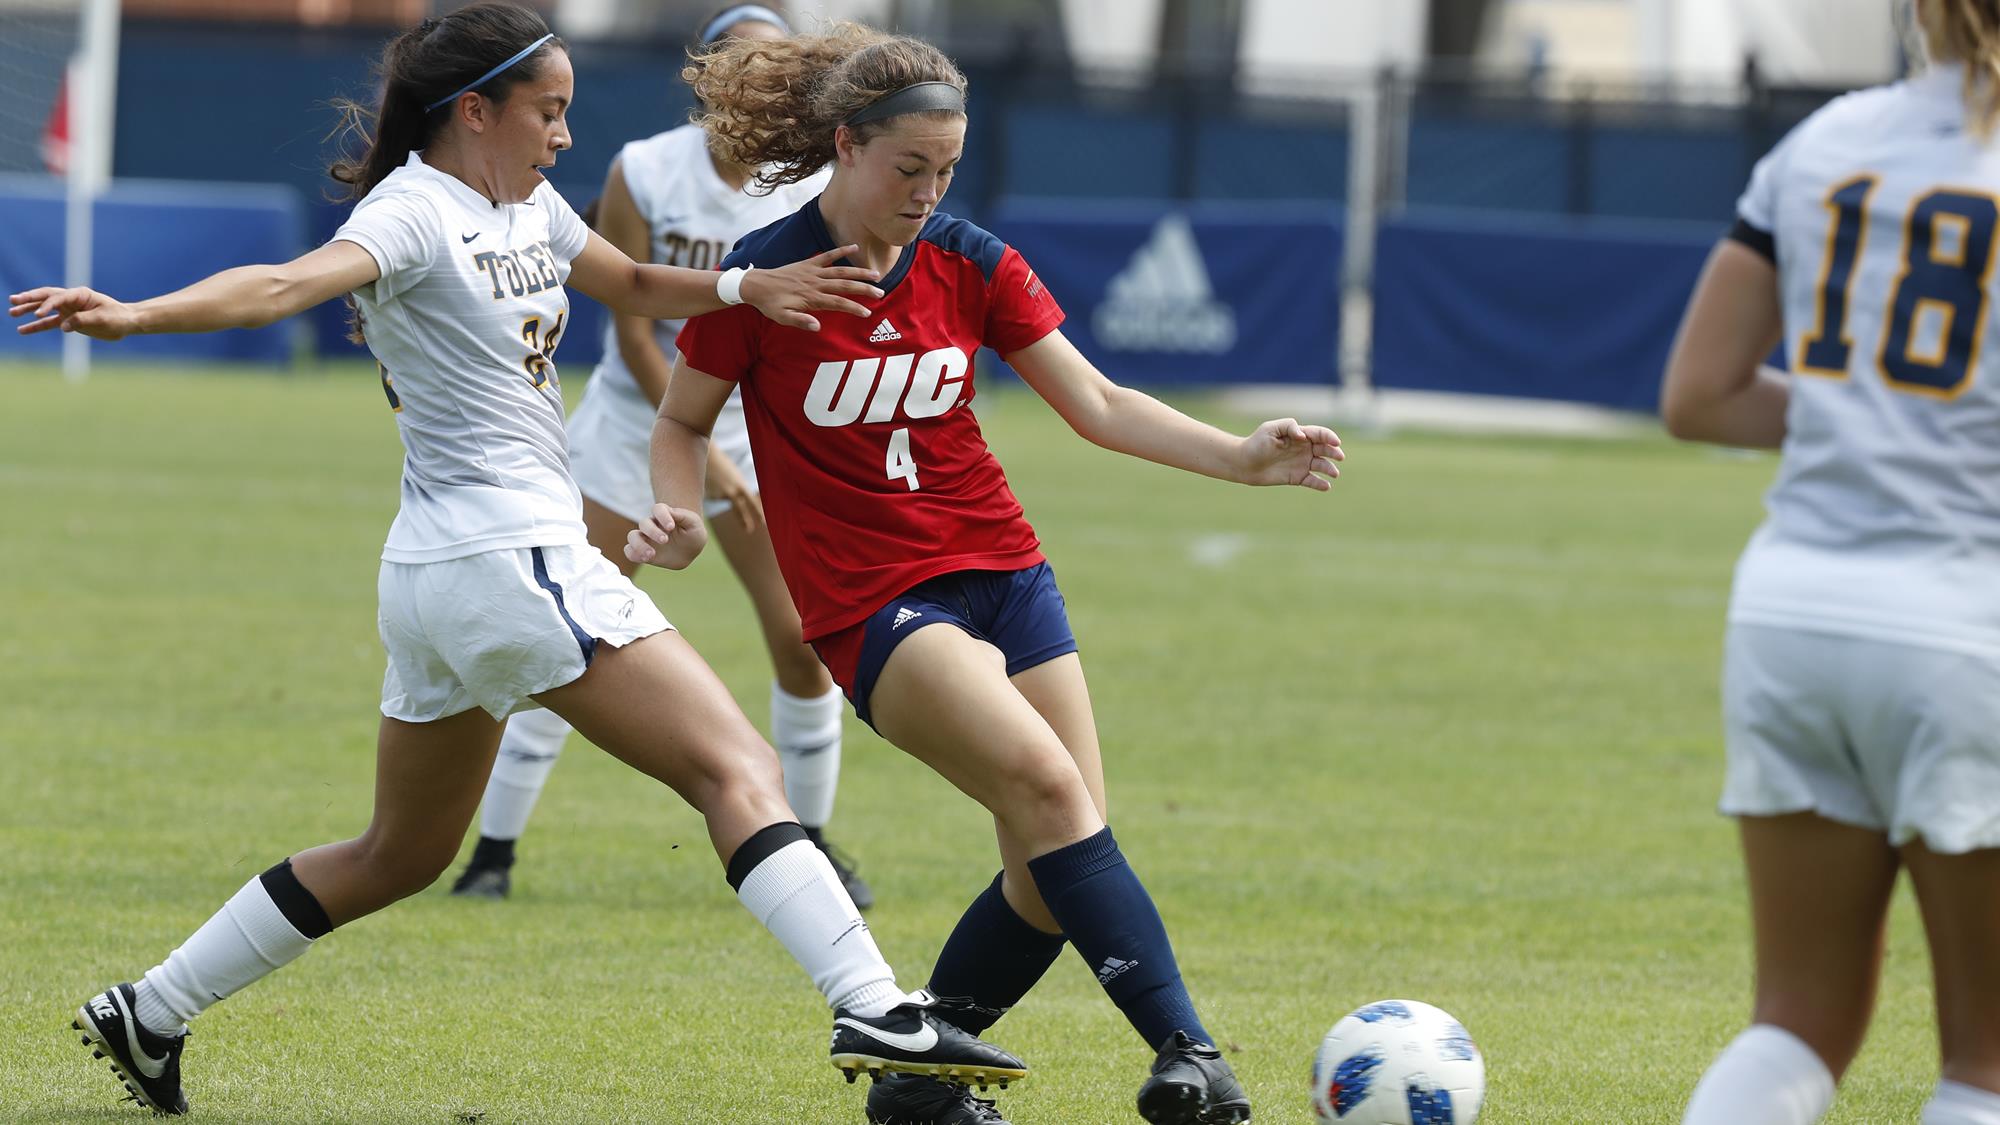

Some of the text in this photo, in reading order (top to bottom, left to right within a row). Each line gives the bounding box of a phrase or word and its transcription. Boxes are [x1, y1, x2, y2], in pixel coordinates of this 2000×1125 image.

[473, 239, 560, 300] TOLE
[1794, 172, 2000, 402] 18
[869, 331, 902, 343] adidas
[803, 346, 969, 428] UIC
[885, 427, 921, 492] 4
[1098, 959, 1140, 985] didas
